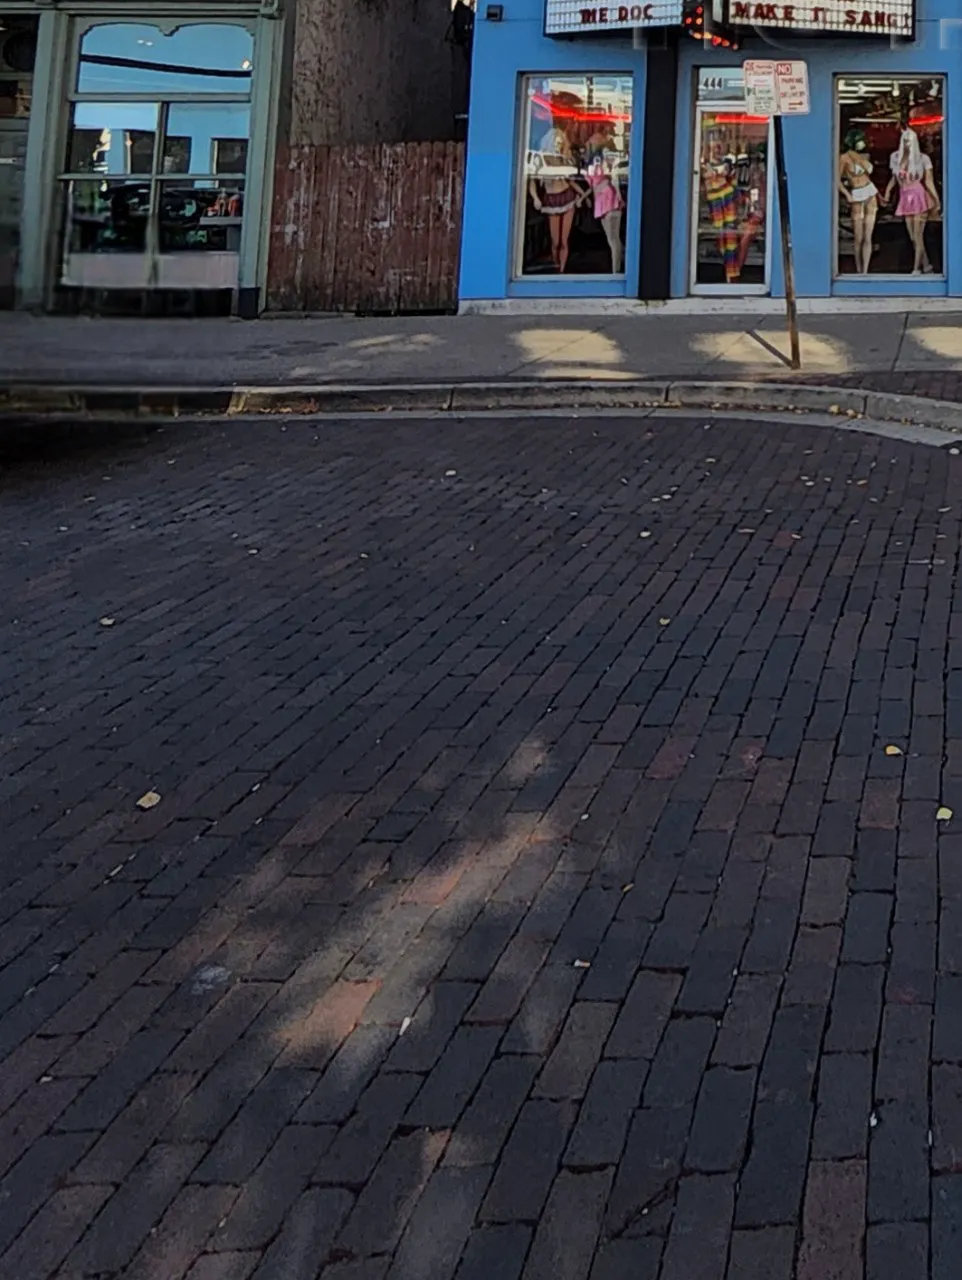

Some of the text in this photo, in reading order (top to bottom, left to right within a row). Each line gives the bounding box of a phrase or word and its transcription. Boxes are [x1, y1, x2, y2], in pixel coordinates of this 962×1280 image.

[580, 3, 654, 24] THE DOC
[733, 2, 795, 21] MAKE
[777, 64, 791, 74] NO
[702, 78, 723, 90] 444
